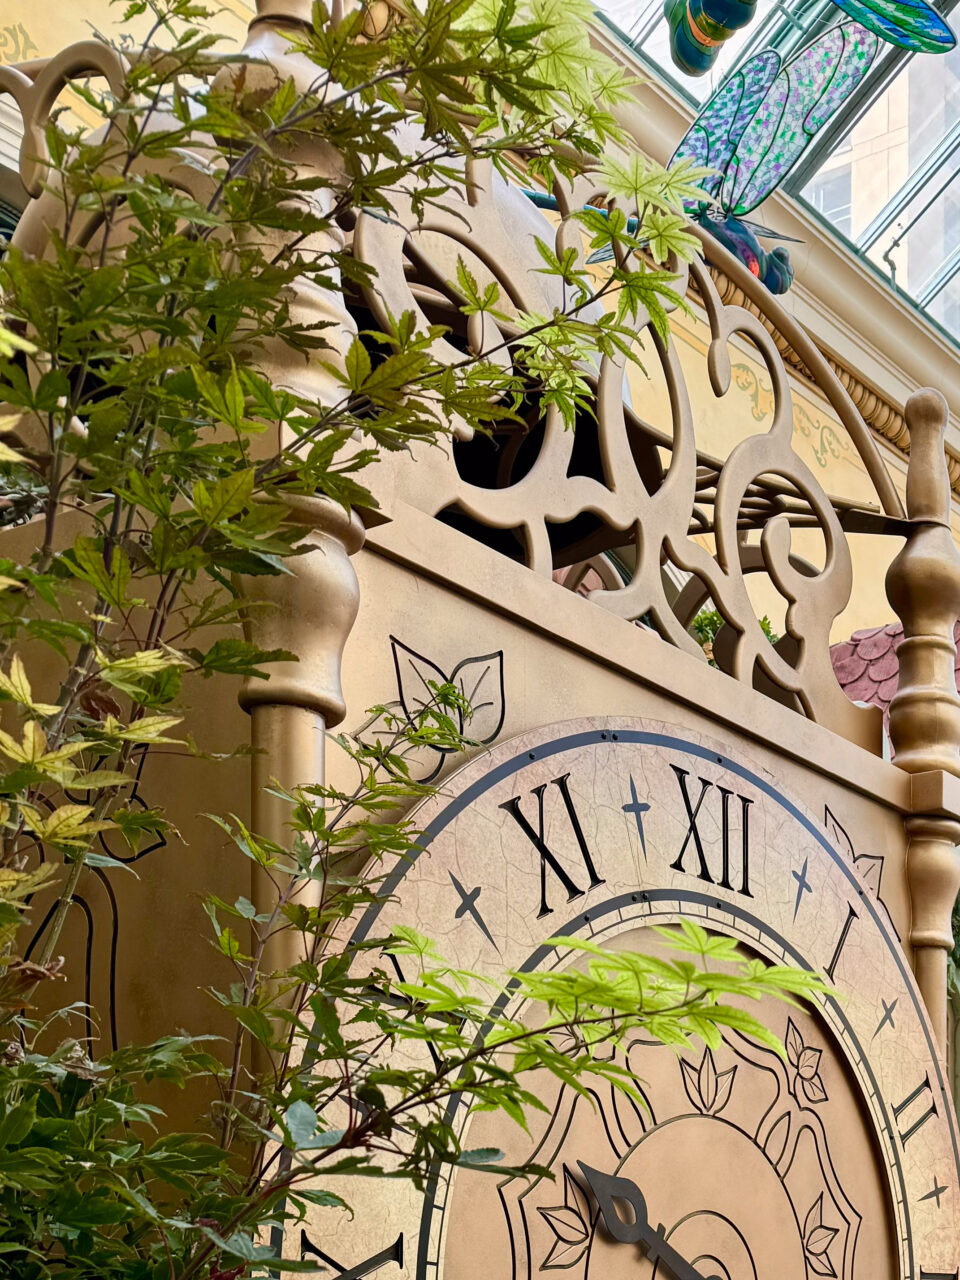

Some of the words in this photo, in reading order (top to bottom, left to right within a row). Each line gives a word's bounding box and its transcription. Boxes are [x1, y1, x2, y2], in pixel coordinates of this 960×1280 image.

[498, 773, 606, 919] XI
[669, 763, 754, 898] XII
[823, 901, 859, 985] I
[891, 1070, 939, 1152] II
